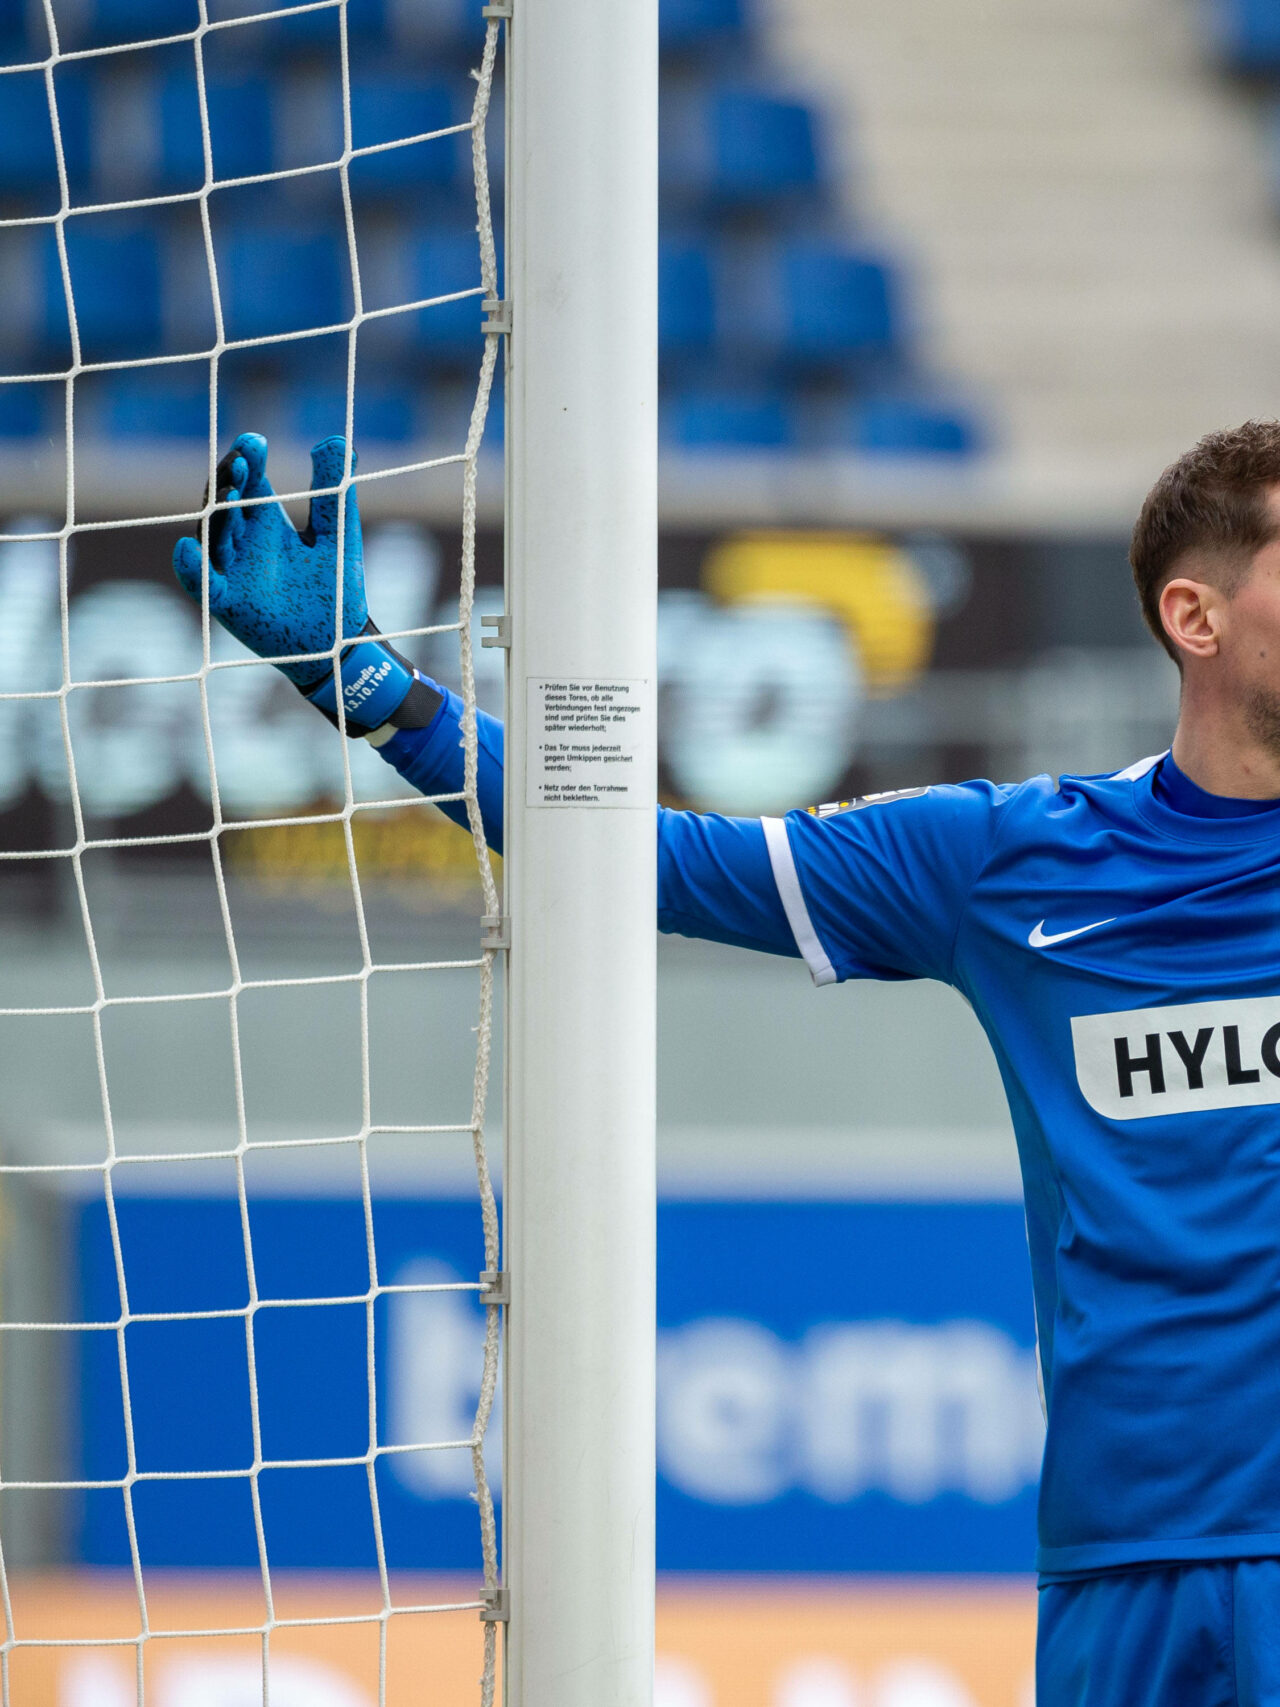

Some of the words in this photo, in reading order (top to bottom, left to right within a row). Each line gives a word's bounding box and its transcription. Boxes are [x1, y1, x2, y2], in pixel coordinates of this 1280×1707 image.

[344, 665, 376, 697] Claudia
[344, 661, 392, 712] 13.10.1960
[545, 683, 567, 691] Prüfen
[595, 684, 629, 693] Benutzung
[569, 694, 589, 702] Tores,
[545, 704, 592, 712] Verbindungen
[594, 704, 607, 712] fest
[576, 714, 598, 723] prüfen
[545, 724, 566, 732] später
[592, 744, 621, 753] jederzeit
[567, 754, 601, 762] Umkippen
[603, 755, 633, 763] gesichert
[544, 764, 572, 772] werden;
[544, 784, 559, 792] Netz
[561, 784, 576, 792] oder
